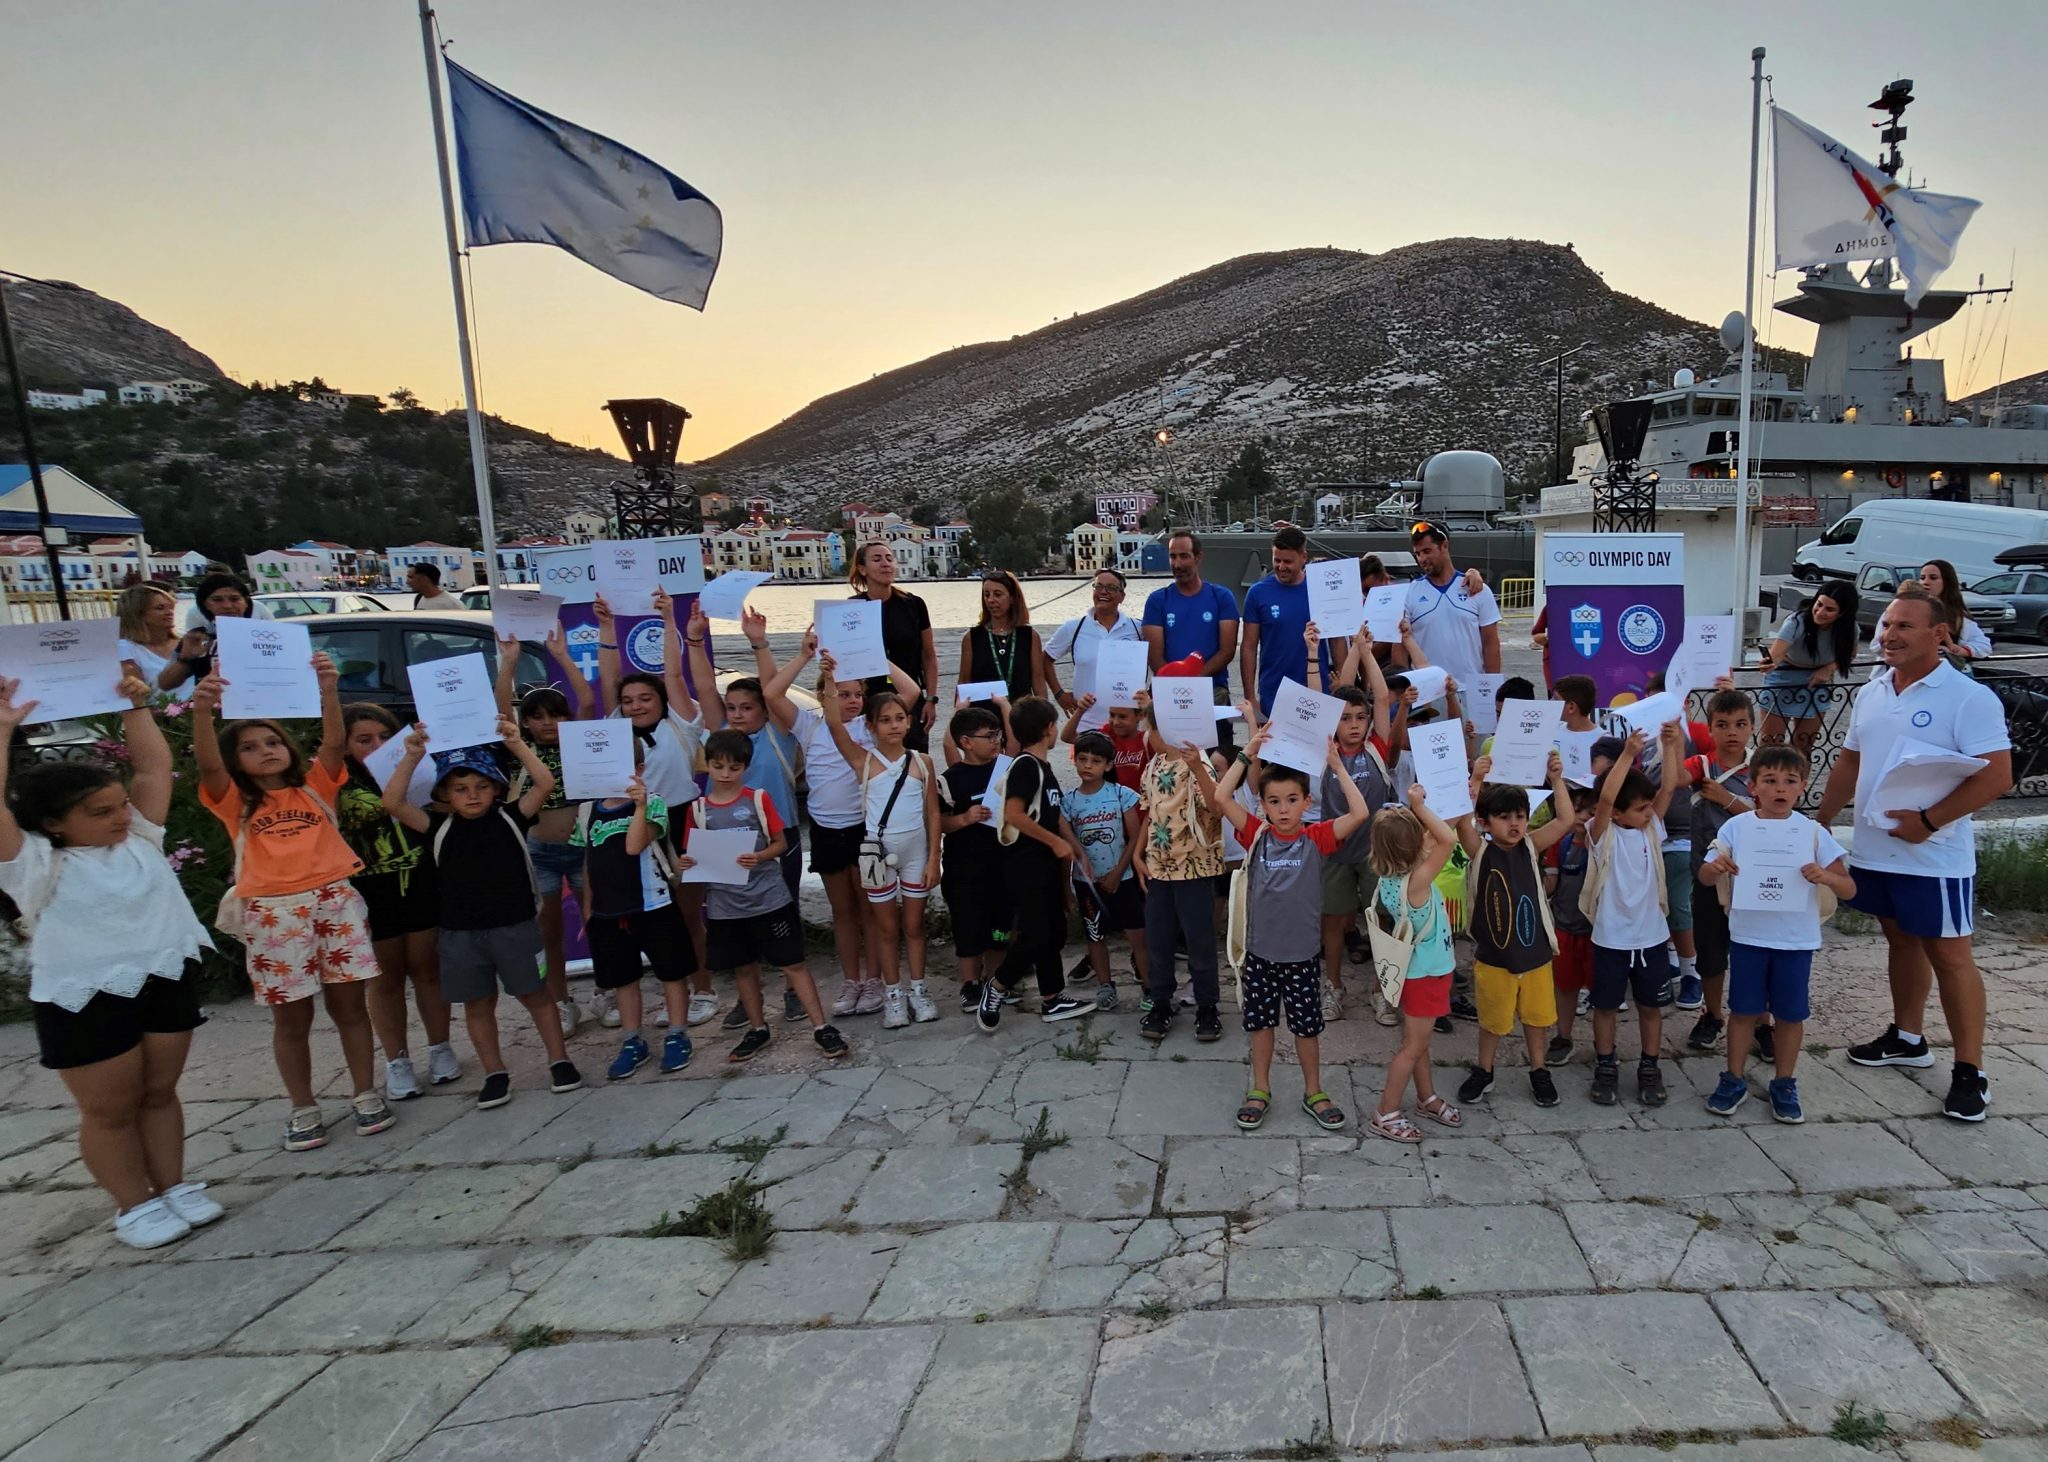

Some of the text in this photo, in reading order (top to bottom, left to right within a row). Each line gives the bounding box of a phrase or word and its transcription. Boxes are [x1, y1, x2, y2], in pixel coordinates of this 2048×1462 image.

[1834, 235, 1888, 254] ΔΗΜΟΣ
[1694, 481, 1737, 494] Yachtin
[1589, 551, 1671, 567] OLYMPIC DAY
[658, 556, 686, 576] DAY
[40, 639, 80, 647] OLYMPIC
[252, 643, 283, 651] OLYMPIC
[261, 649, 276, 657] DAY
[1295, 707, 1318, 719] OLYMPIC
[1299, 714, 1310, 722] DAY
[1431, 745, 1450, 754] OLYMPIC
[1437, 752, 1446, 760] DAY
